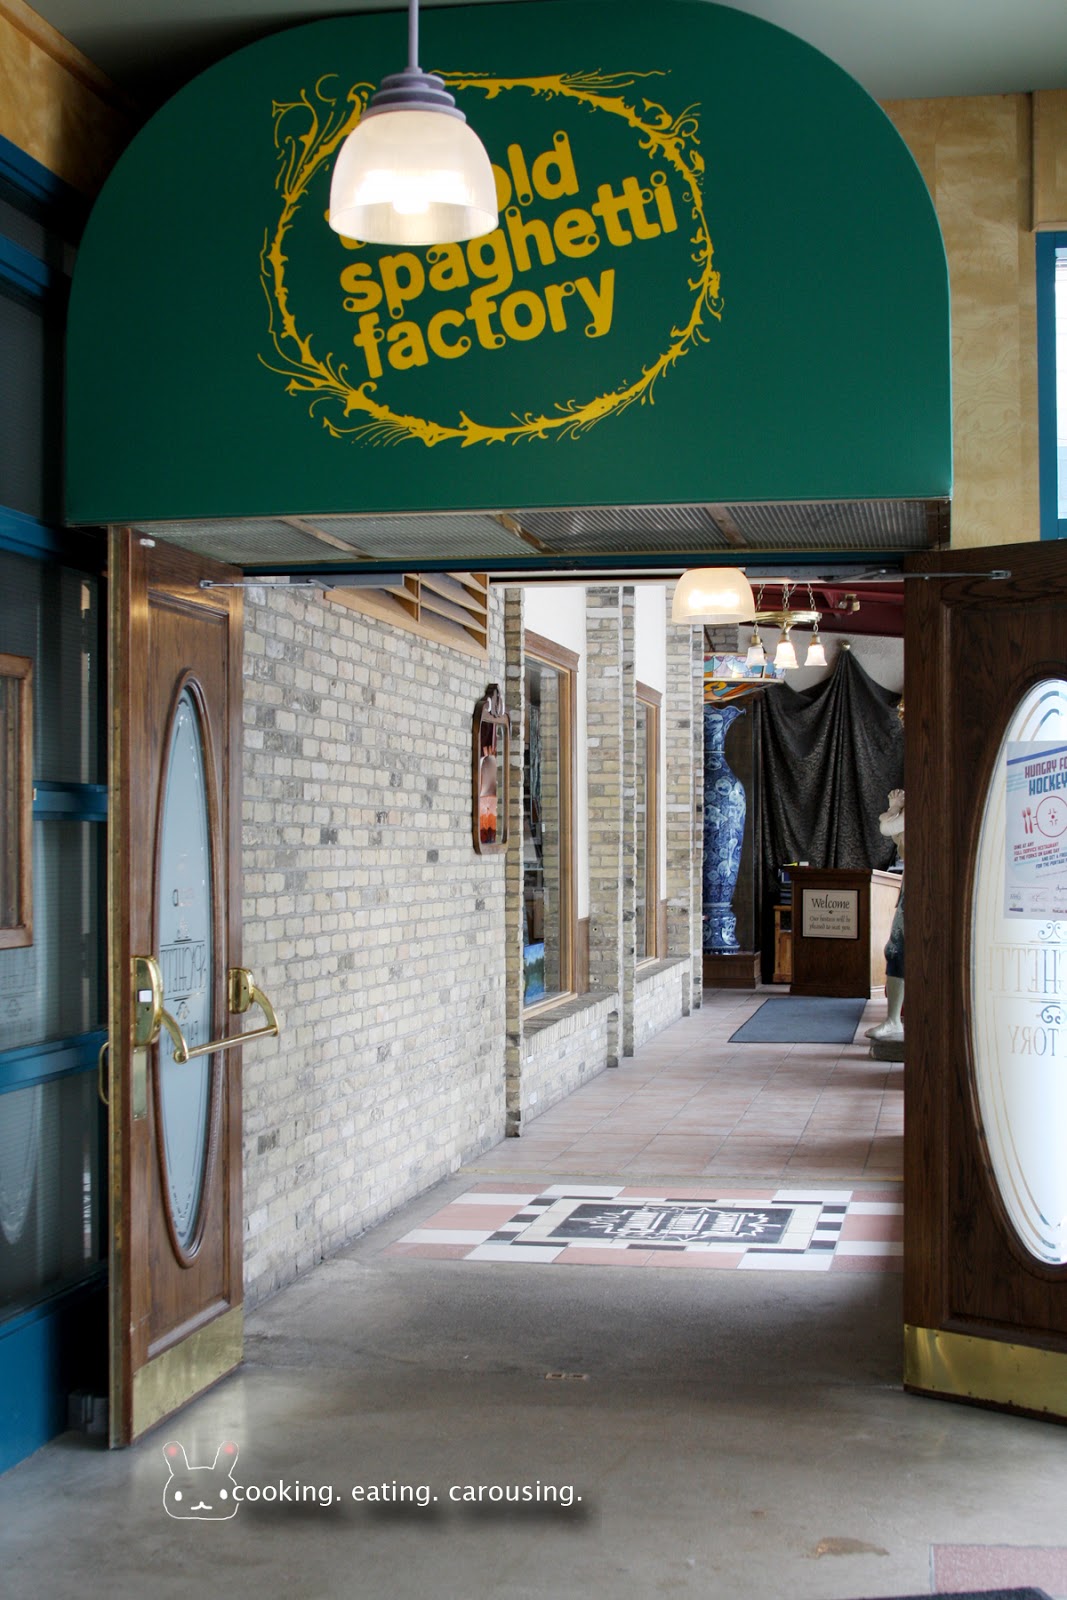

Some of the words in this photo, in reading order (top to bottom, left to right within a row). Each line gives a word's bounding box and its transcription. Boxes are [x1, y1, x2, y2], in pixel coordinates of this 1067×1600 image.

[339, 170, 677, 319] spaghetti
[353, 269, 615, 379] factory
[1024, 759, 1057, 779] HUNGRY
[1028, 771, 1067, 796] HOCKEY
[811, 894, 850, 909] Welcome
